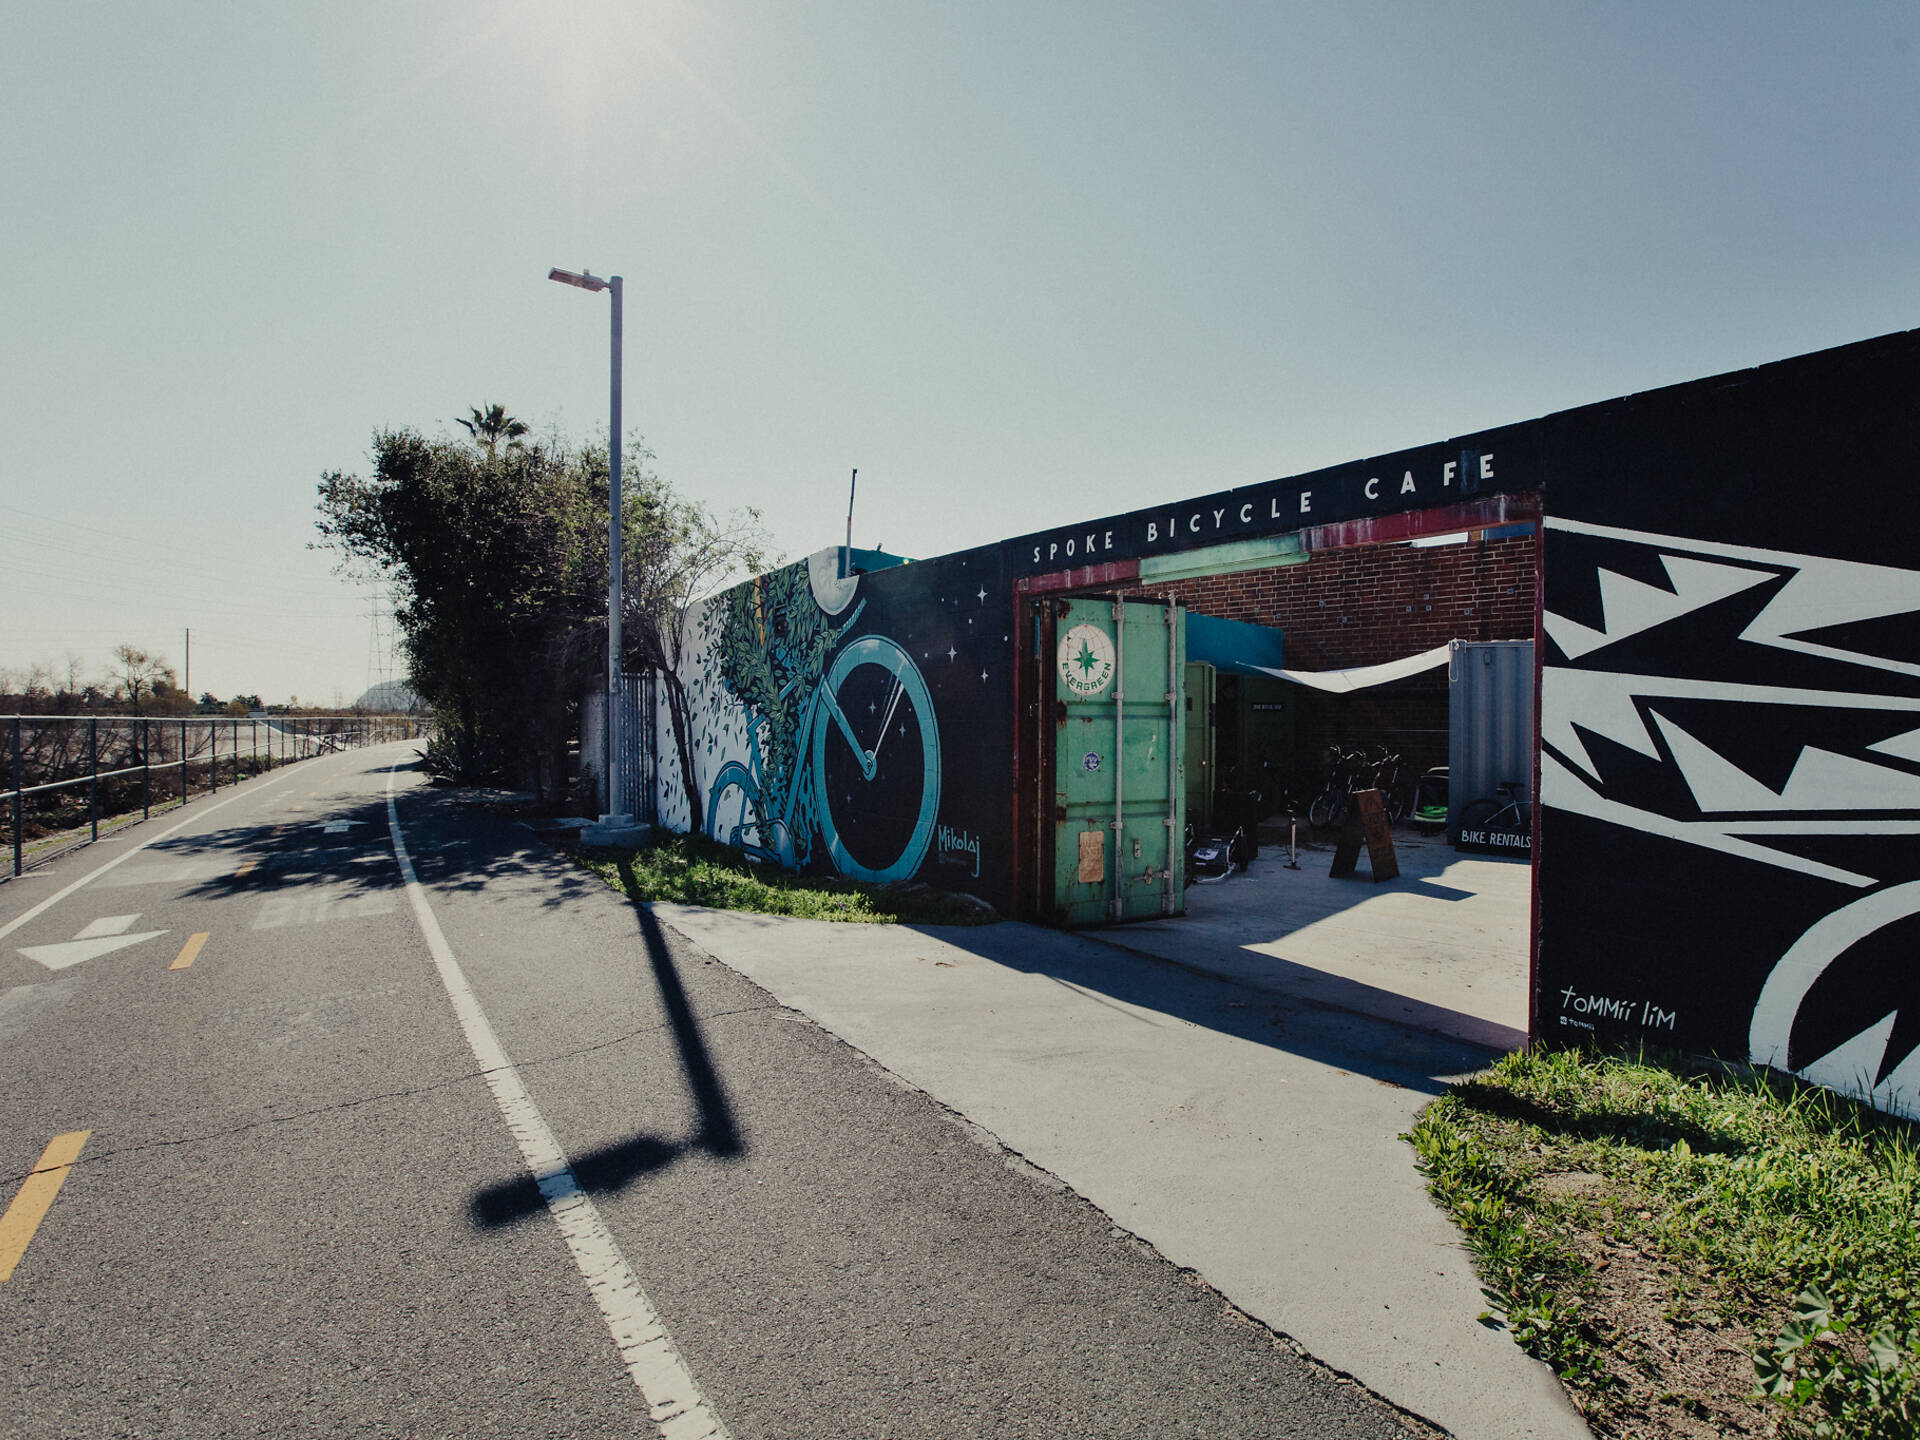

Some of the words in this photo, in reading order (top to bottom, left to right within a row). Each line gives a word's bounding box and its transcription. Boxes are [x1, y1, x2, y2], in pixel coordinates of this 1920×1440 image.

[1033, 531, 1113, 563] SPOKE
[1147, 491, 1312, 542] BICYCLE
[1364, 454, 1495, 500] CAFE
[1062, 662, 1111, 691] EVERGREEN
[938, 824, 980, 878] Mikolaj
[1461, 829, 1487, 844] BIKE
[1489, 832, 1532, 849] RENTALS
